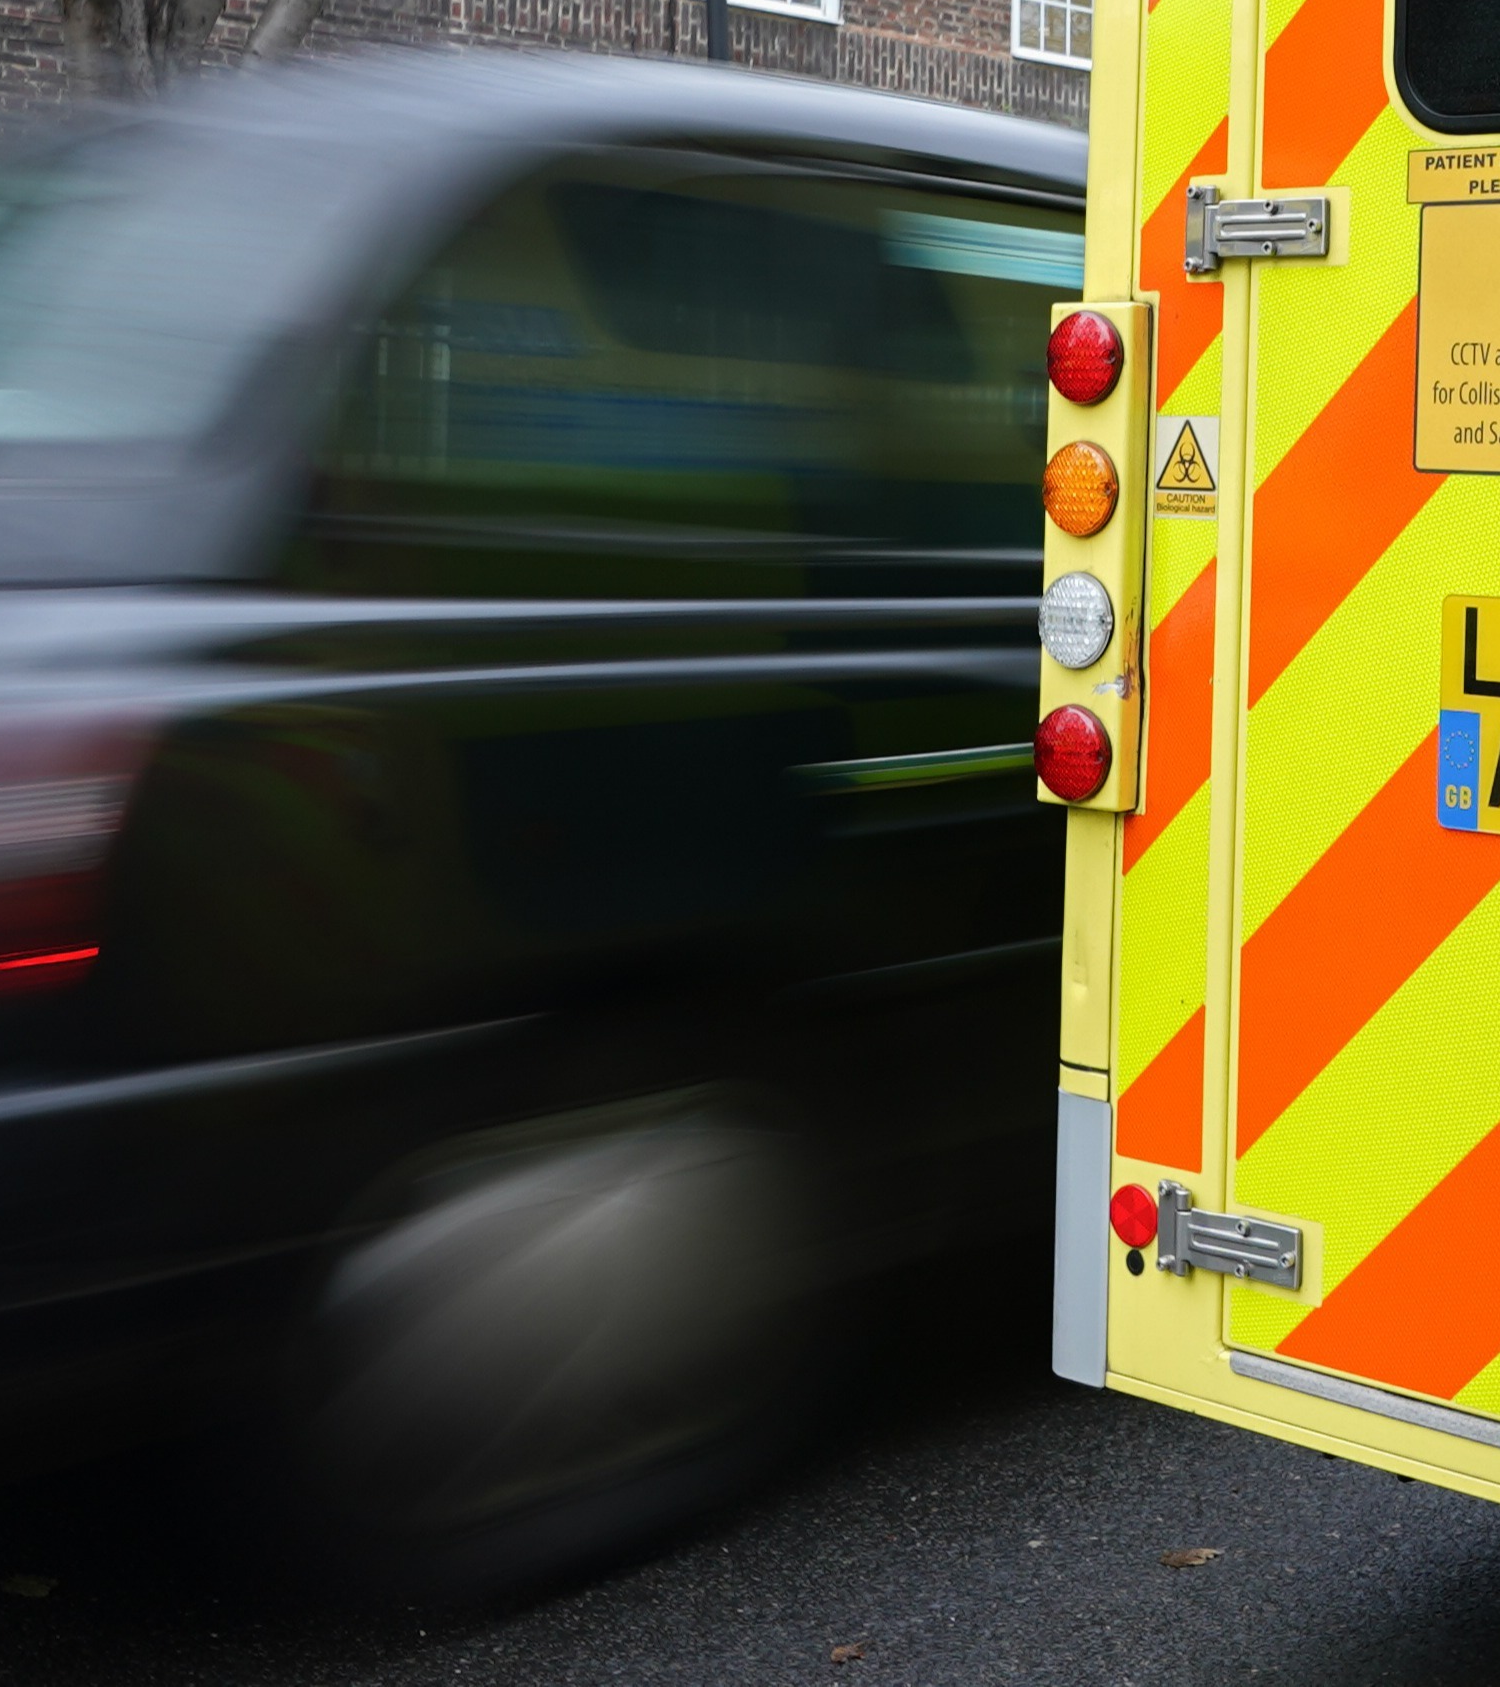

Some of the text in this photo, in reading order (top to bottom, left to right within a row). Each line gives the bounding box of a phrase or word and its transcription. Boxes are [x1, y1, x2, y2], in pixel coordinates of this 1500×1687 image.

[1426, 153, 1497, 170] PATIENT
[1451, 343, 1490, 365] CCTV
[1433, 381, 1455, 404] for
[1454, 421, 1483, 444] and
[1157, 504, 1215, 513] Biological hazard
[1166, 493, 1206, 503] CAUTION
[1445, 785, 1472, 809] GB
